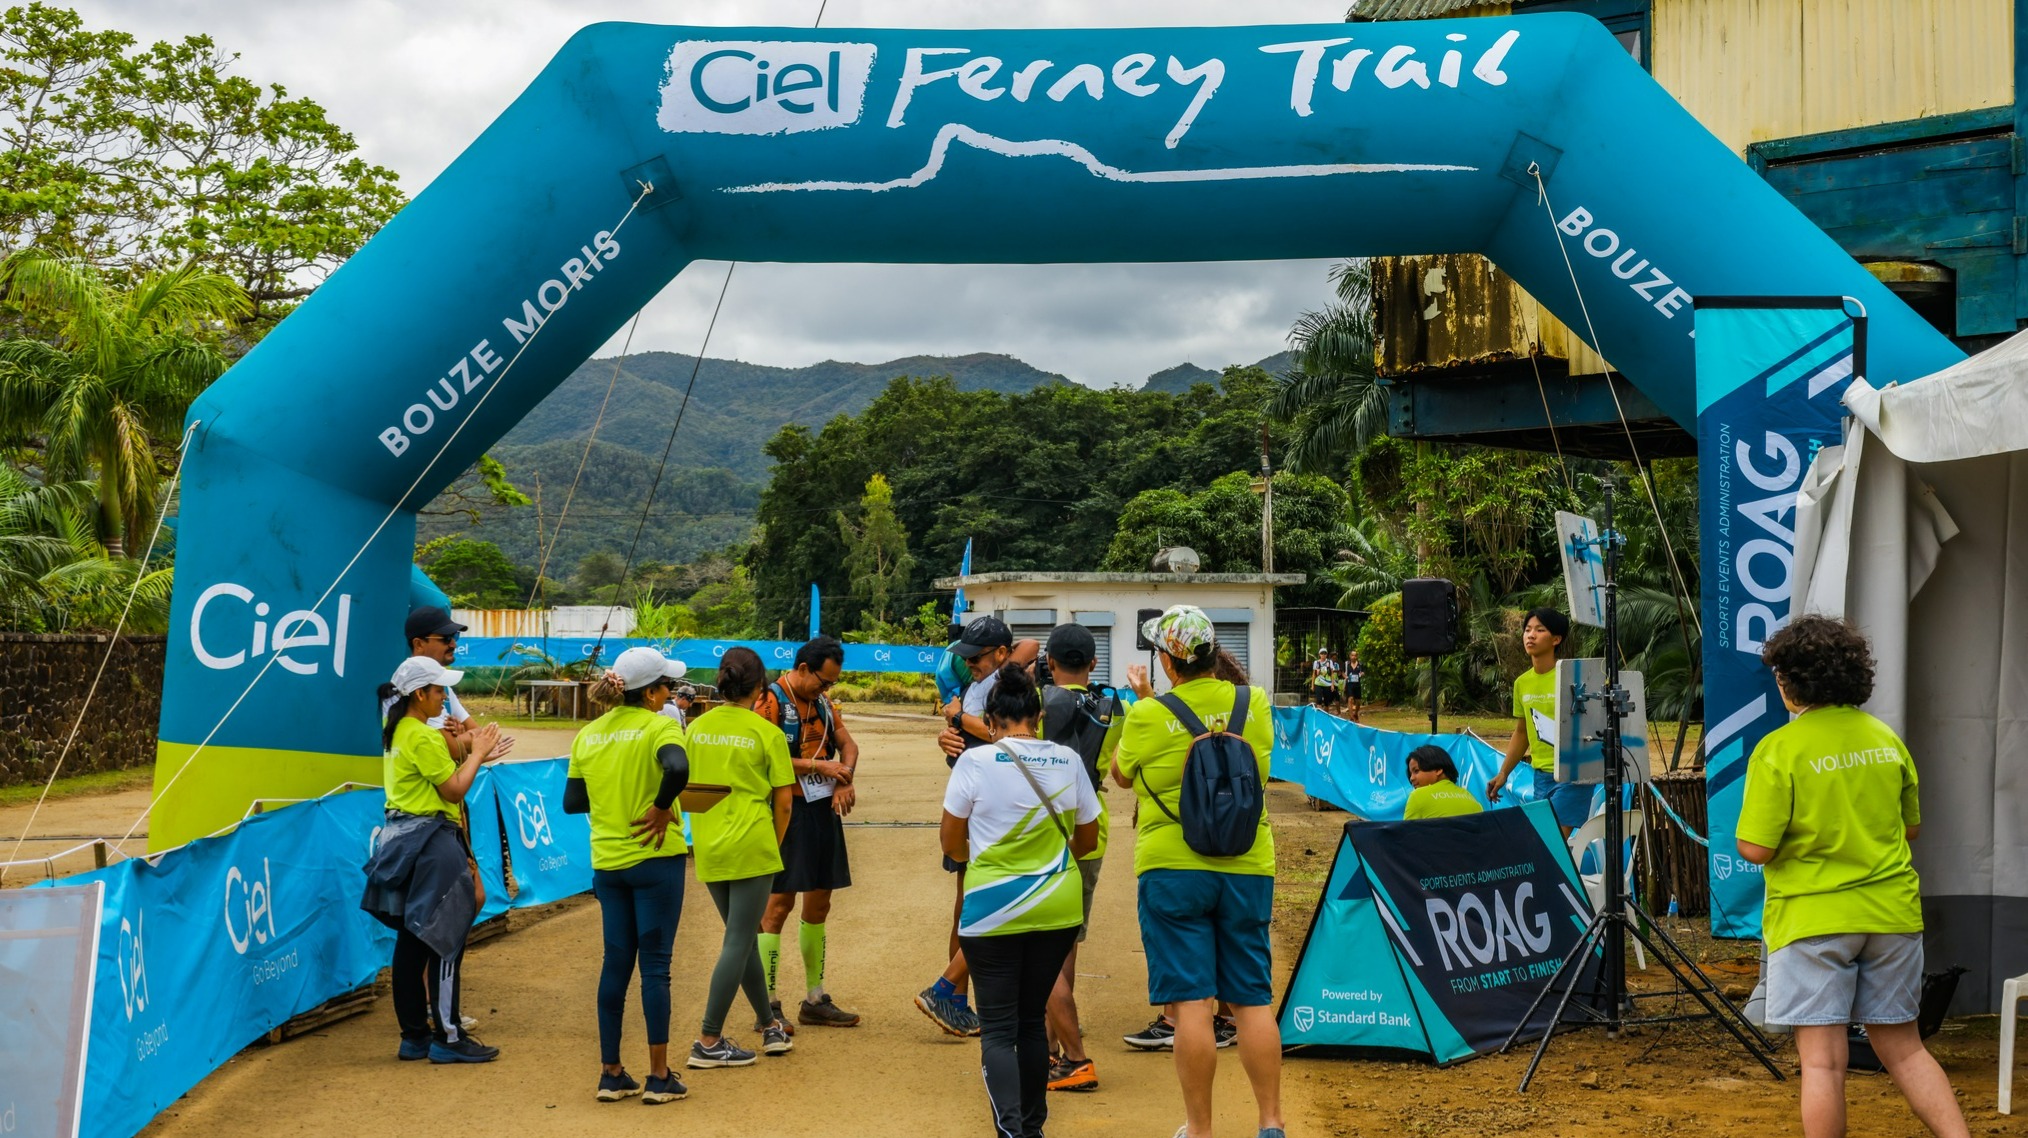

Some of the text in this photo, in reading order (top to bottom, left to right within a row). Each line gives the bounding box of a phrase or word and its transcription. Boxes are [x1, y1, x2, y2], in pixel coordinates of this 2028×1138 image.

[690, 30, 1521, 149] Ciel Ferney Trail
[1556, 205, 1694, 320] BOUZE
[378, 230, 621, 458] BOUZE MORIS
[1718, 422, 1731, 648] SPORTS EVENTS ADMINISTRATION
[1735, 430, 1801, 656] ROAG
[189, 582, 352, 678] Ciel
[774, 646, 794, 659] Ciel
[874, 649, 891, 662] Ciel
[918, 651, 934, 663] Ciel
[584, 729, 644, 747] VOLUNTEER
[692, 733, 756, 750] VOLUNTEER
[1050, 757, 1069, 765] Trail
[1368, 744, 1387, 787] Ciel
[1809, 746, 1900, 775] VOLUNTEER
[515, 790, 554, 850] Ciel
[538, 854, 568, 872] Go Beyond
[1420, 862, 1535, 891] SPORTS EVENTS ADMINISTRATION
[225, 856, 276, 955] Ciel
[1425, 881, 1552, 972] ROAG
[117, 907, 150, 1024] Ciel
[252, 947, 298, 985] Go Beyond
[768, 950, 779, 991] Kalenji
[1450, 957, 1563, 996] FROM START TO FINISH
[1321, 988, 1383, 1003] Powered by
[1317, 1009, 1411, 1028] Standard Bank
[136, 1018, 169, 1062] Go Beyond
